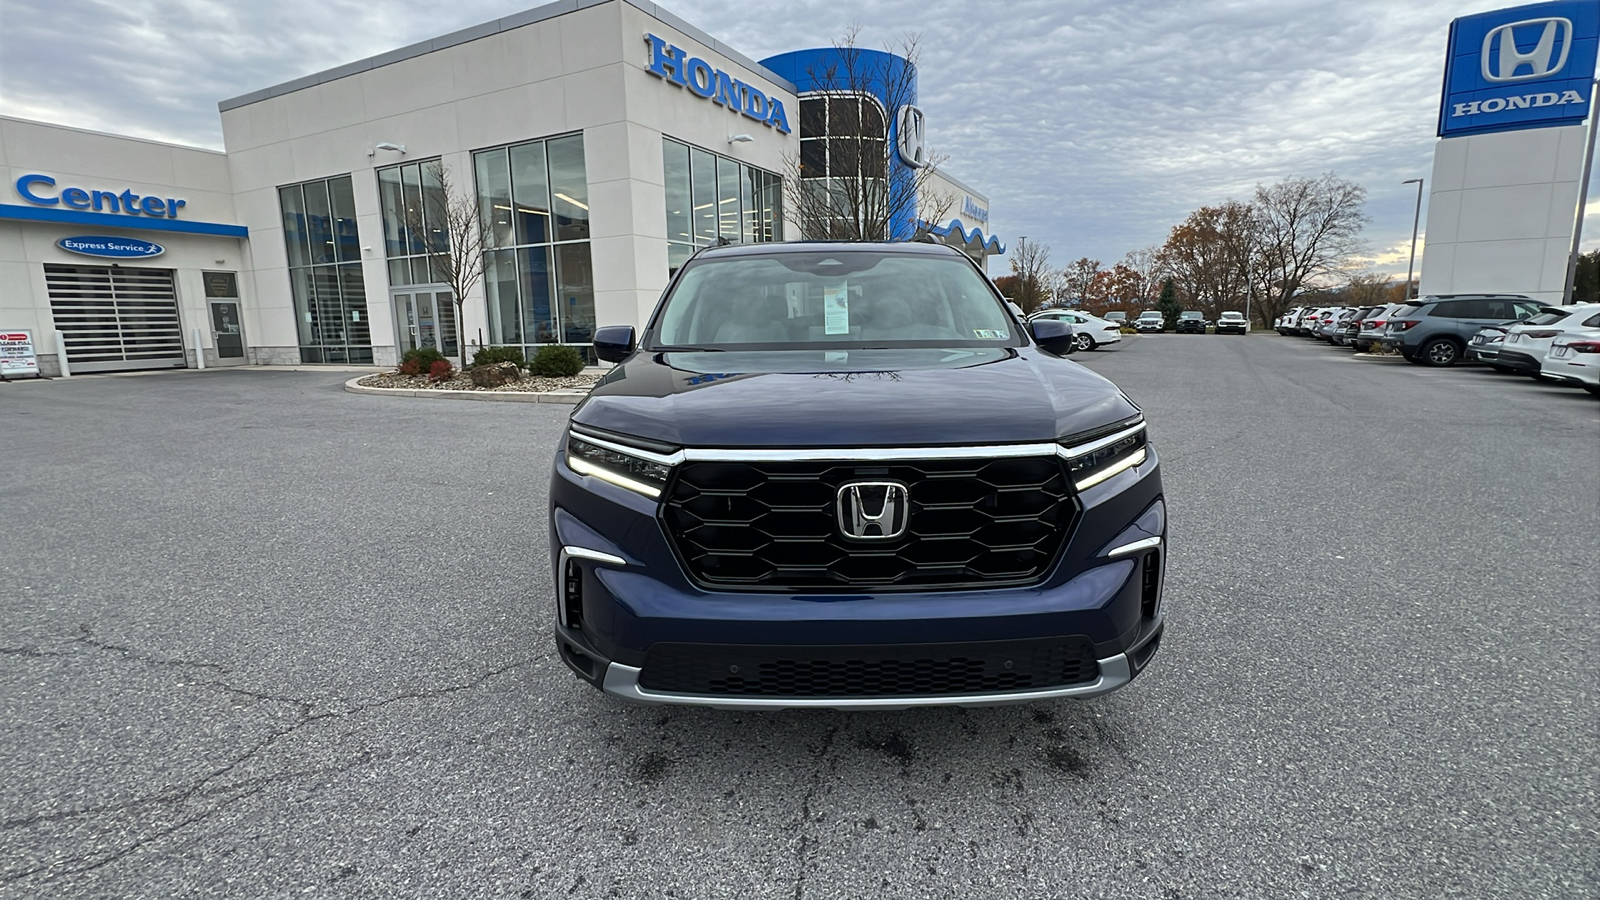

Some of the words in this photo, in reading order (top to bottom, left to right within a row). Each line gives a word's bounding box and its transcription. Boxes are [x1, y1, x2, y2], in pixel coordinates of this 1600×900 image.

[643, 32, 792, 134] HONDA
[1452, 90, 1585, 117] HONDA
[16, 174, 186, 218] Center
[64, 240, 106, 251] Express
[107, 242, 144, 252] Service
